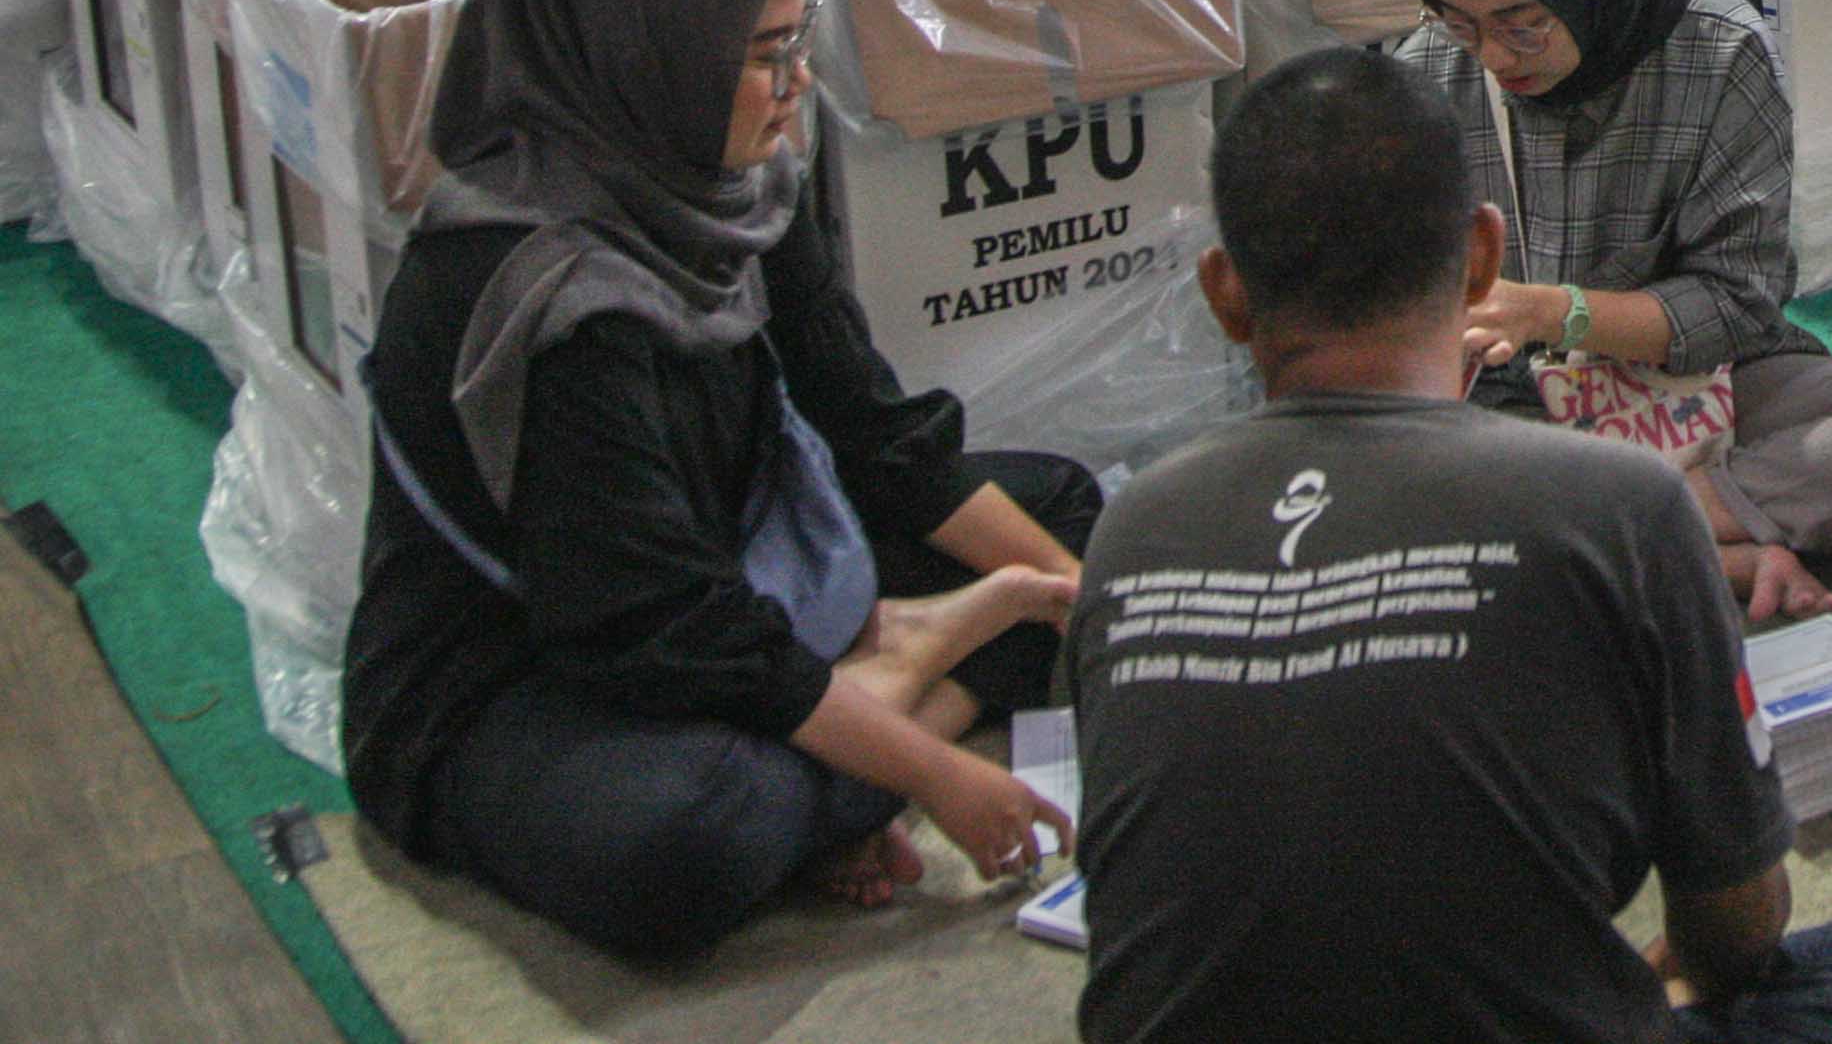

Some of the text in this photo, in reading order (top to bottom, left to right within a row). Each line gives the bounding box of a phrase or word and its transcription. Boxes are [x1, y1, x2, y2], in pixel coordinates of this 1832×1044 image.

[939, 93, 1146, 218] KPU
[972, 204, 1131, 269] PEMILU
[922, 265, 1070, 328] TAHUN
[1538, 360, 1655, 424] GEN
